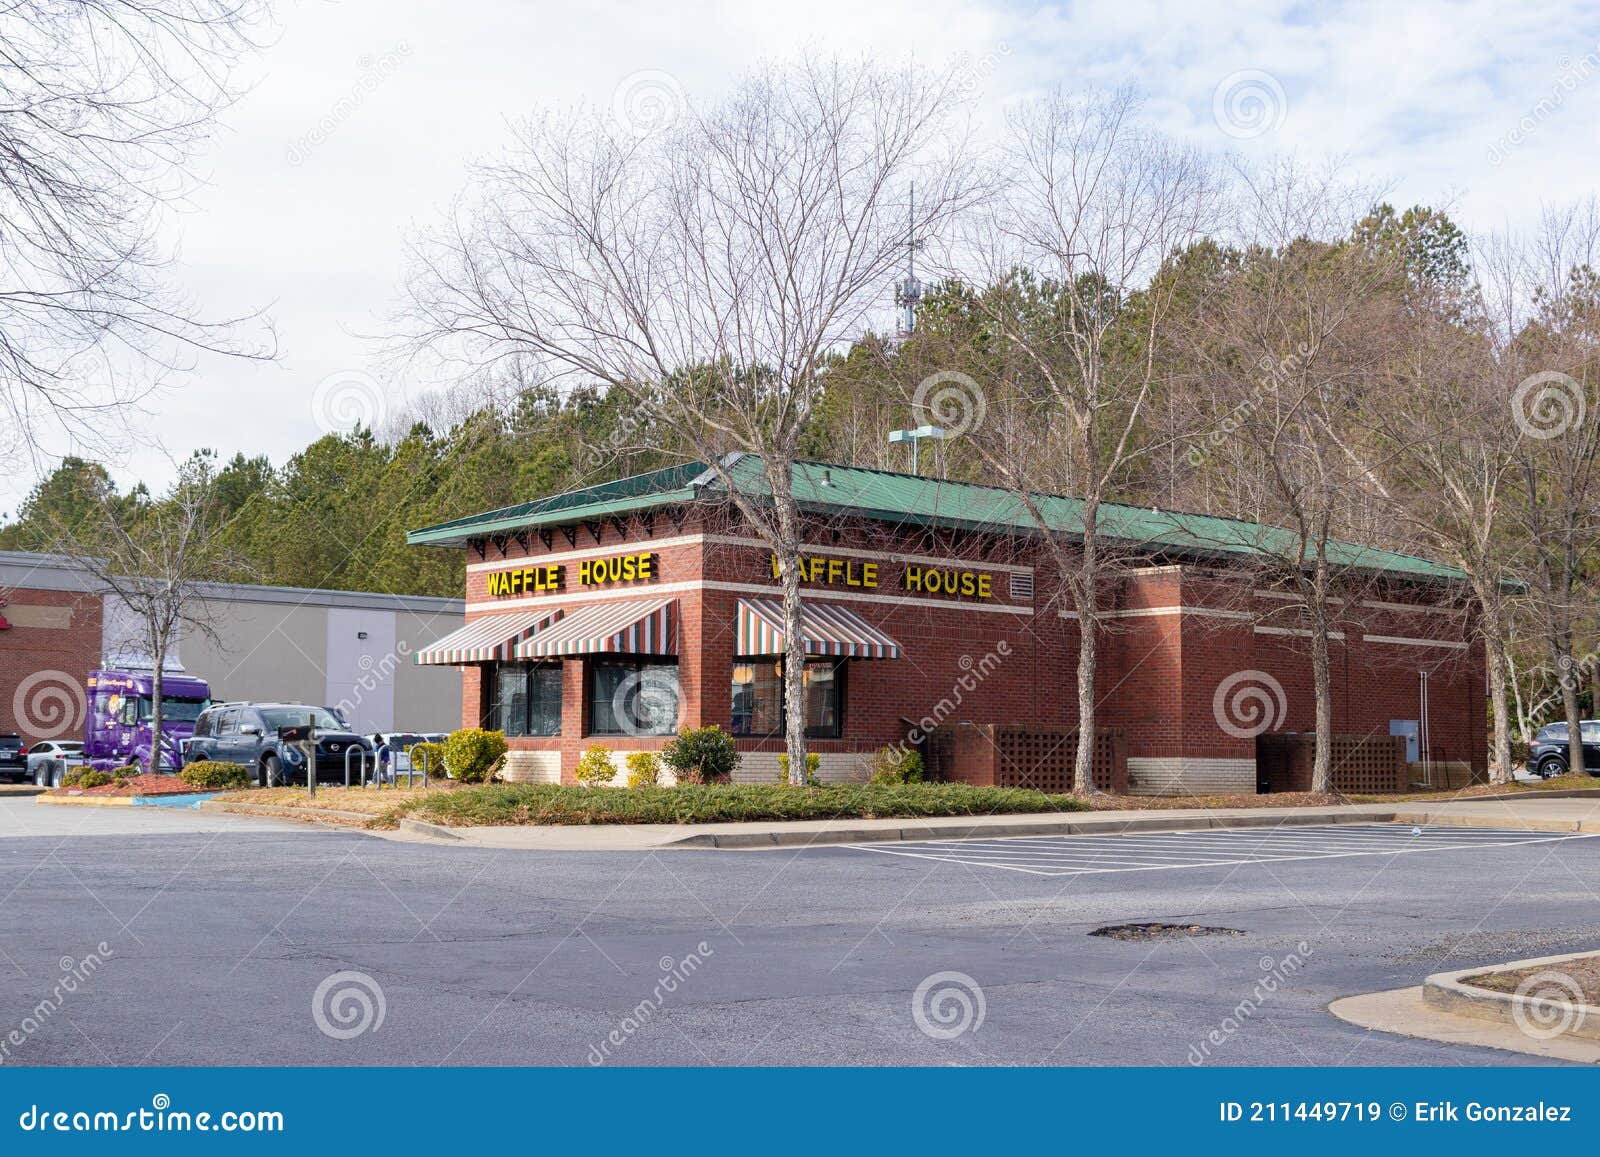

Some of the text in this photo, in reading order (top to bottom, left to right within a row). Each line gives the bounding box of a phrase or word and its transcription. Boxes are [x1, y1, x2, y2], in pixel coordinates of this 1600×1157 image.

[487, 553, 651, 595] WAFFLE HOUSE
[907, 567, 992, 597] HOUSE
